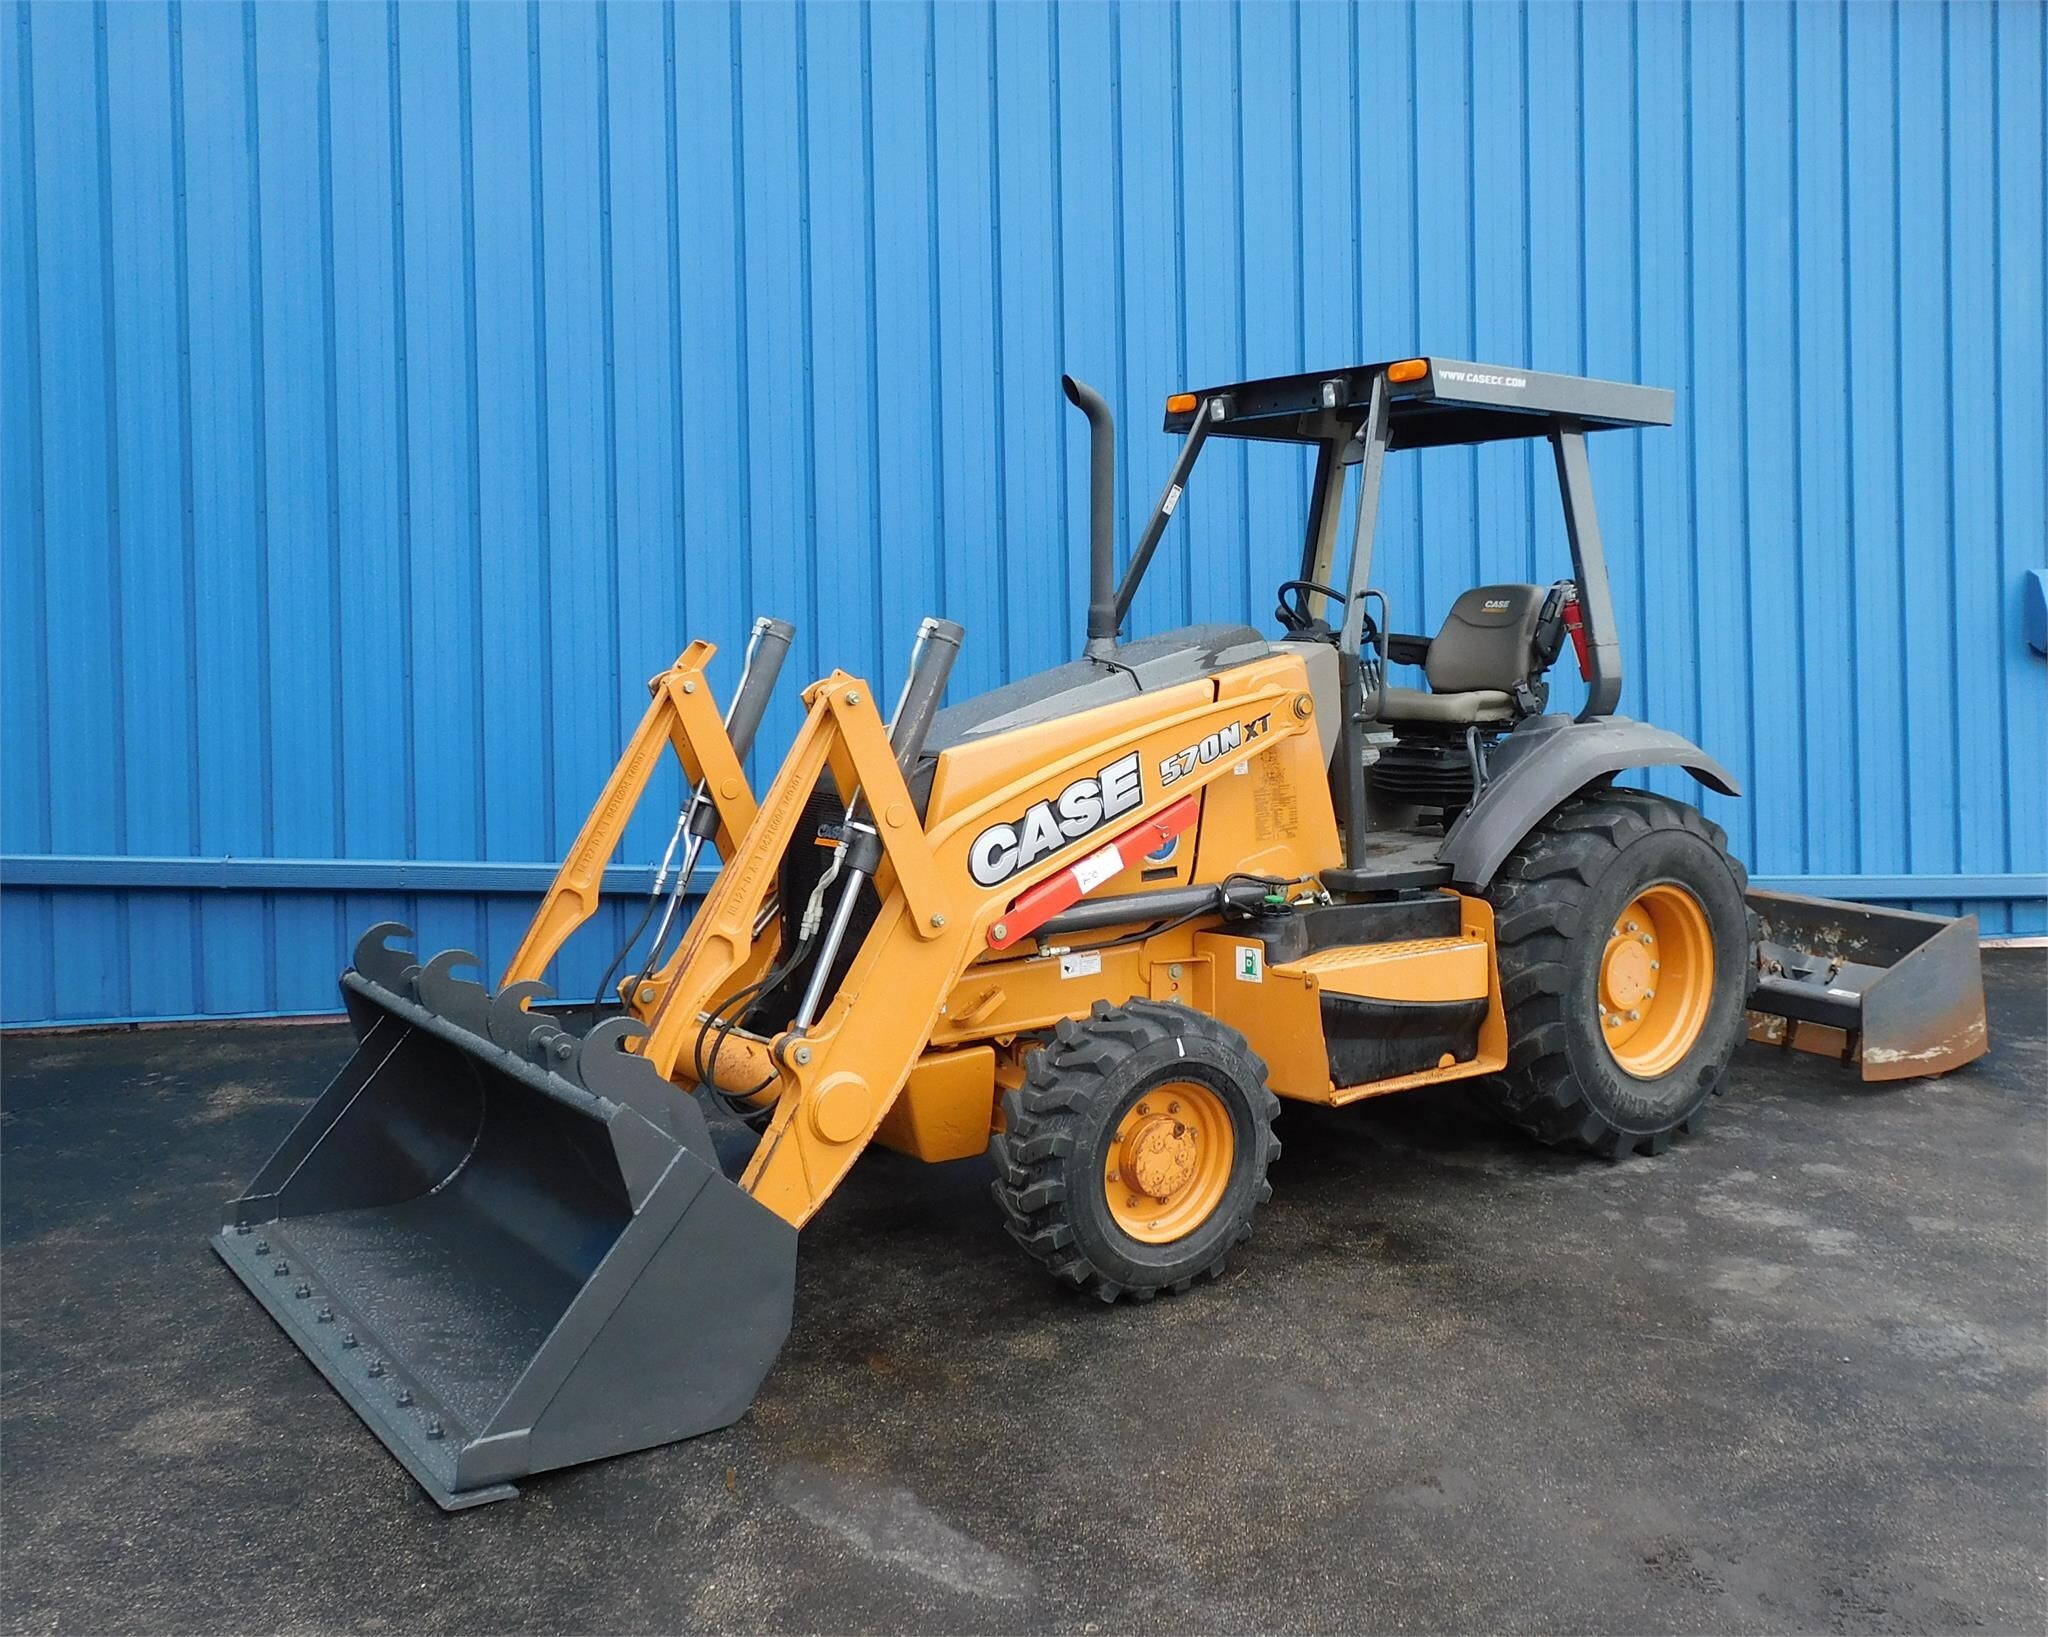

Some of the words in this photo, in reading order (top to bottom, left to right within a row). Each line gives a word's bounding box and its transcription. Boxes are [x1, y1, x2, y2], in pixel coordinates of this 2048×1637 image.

[1438, 370, 1527, 388] WWW.CASECE.COM
[1484, 600, 1511, 608] CASE
[1159, 720, 1241, 787] 570N
[1244, 712, 1271, 742] XT
[968, 750, 1143, 888] CASE
